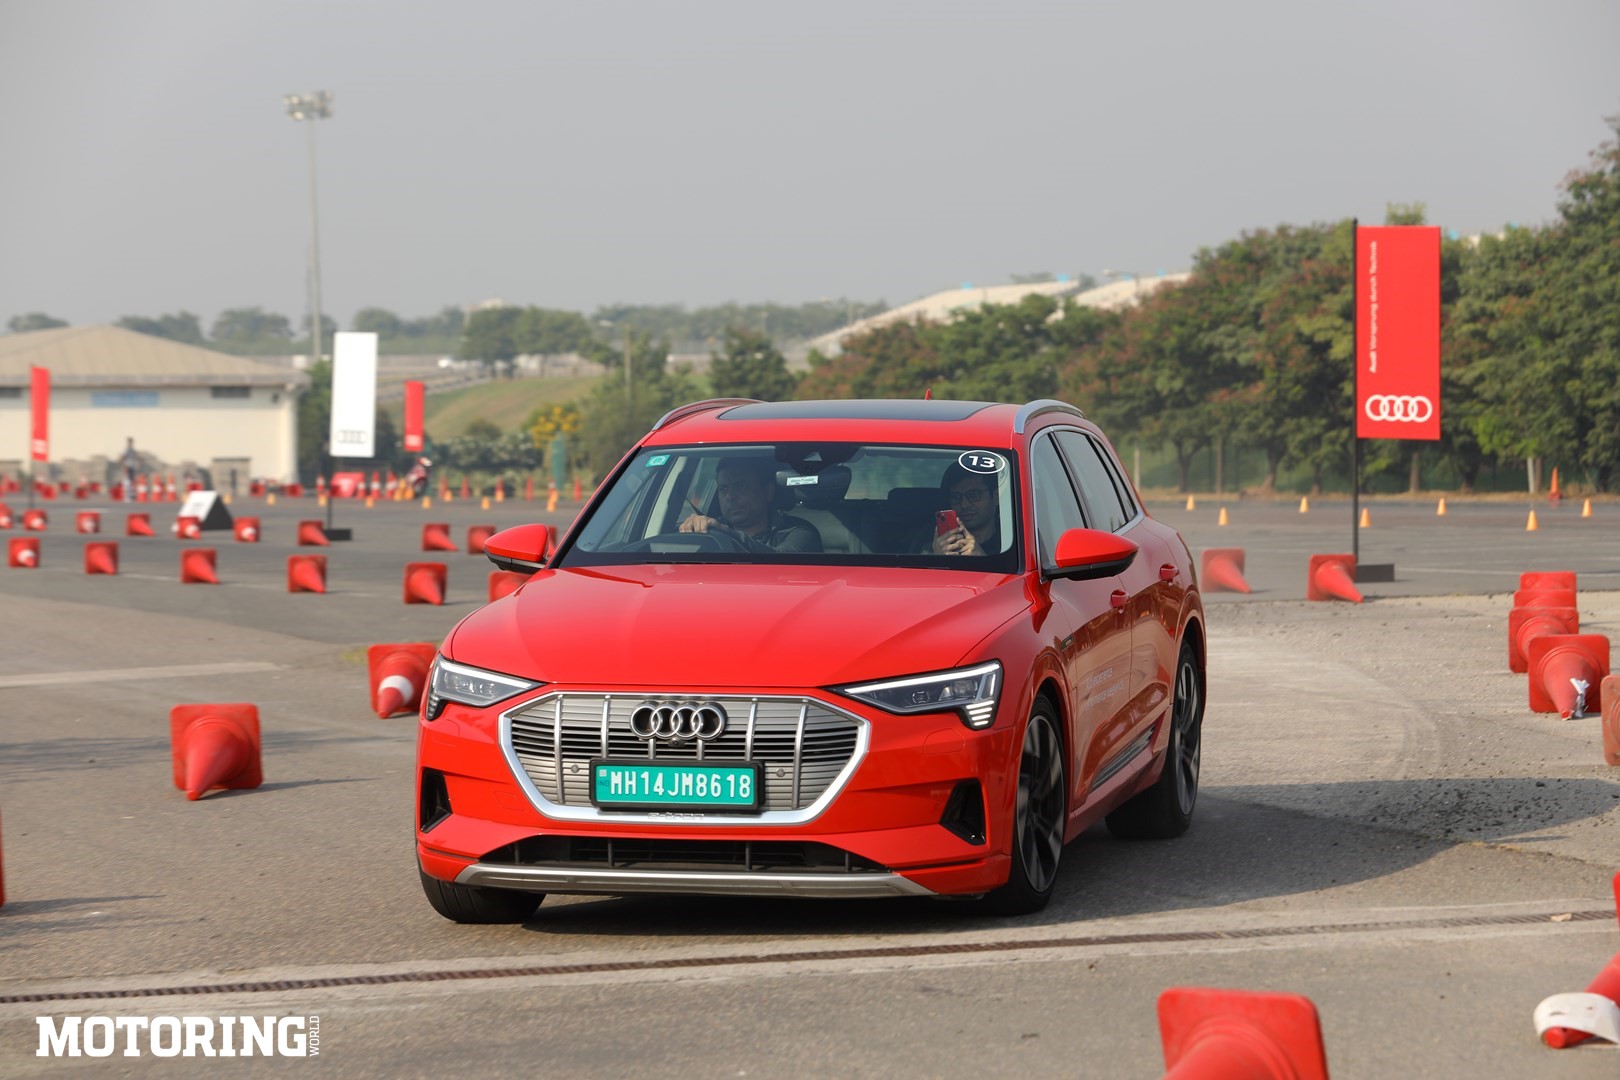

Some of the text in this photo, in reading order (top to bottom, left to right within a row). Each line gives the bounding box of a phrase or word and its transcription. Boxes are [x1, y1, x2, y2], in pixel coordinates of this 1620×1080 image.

[1369, 241, 1378, 373] Audi Vorsprung durch Technik
[968, 455, 995, 468] 13
[610, 771, 751, 798] MH14JM8618
